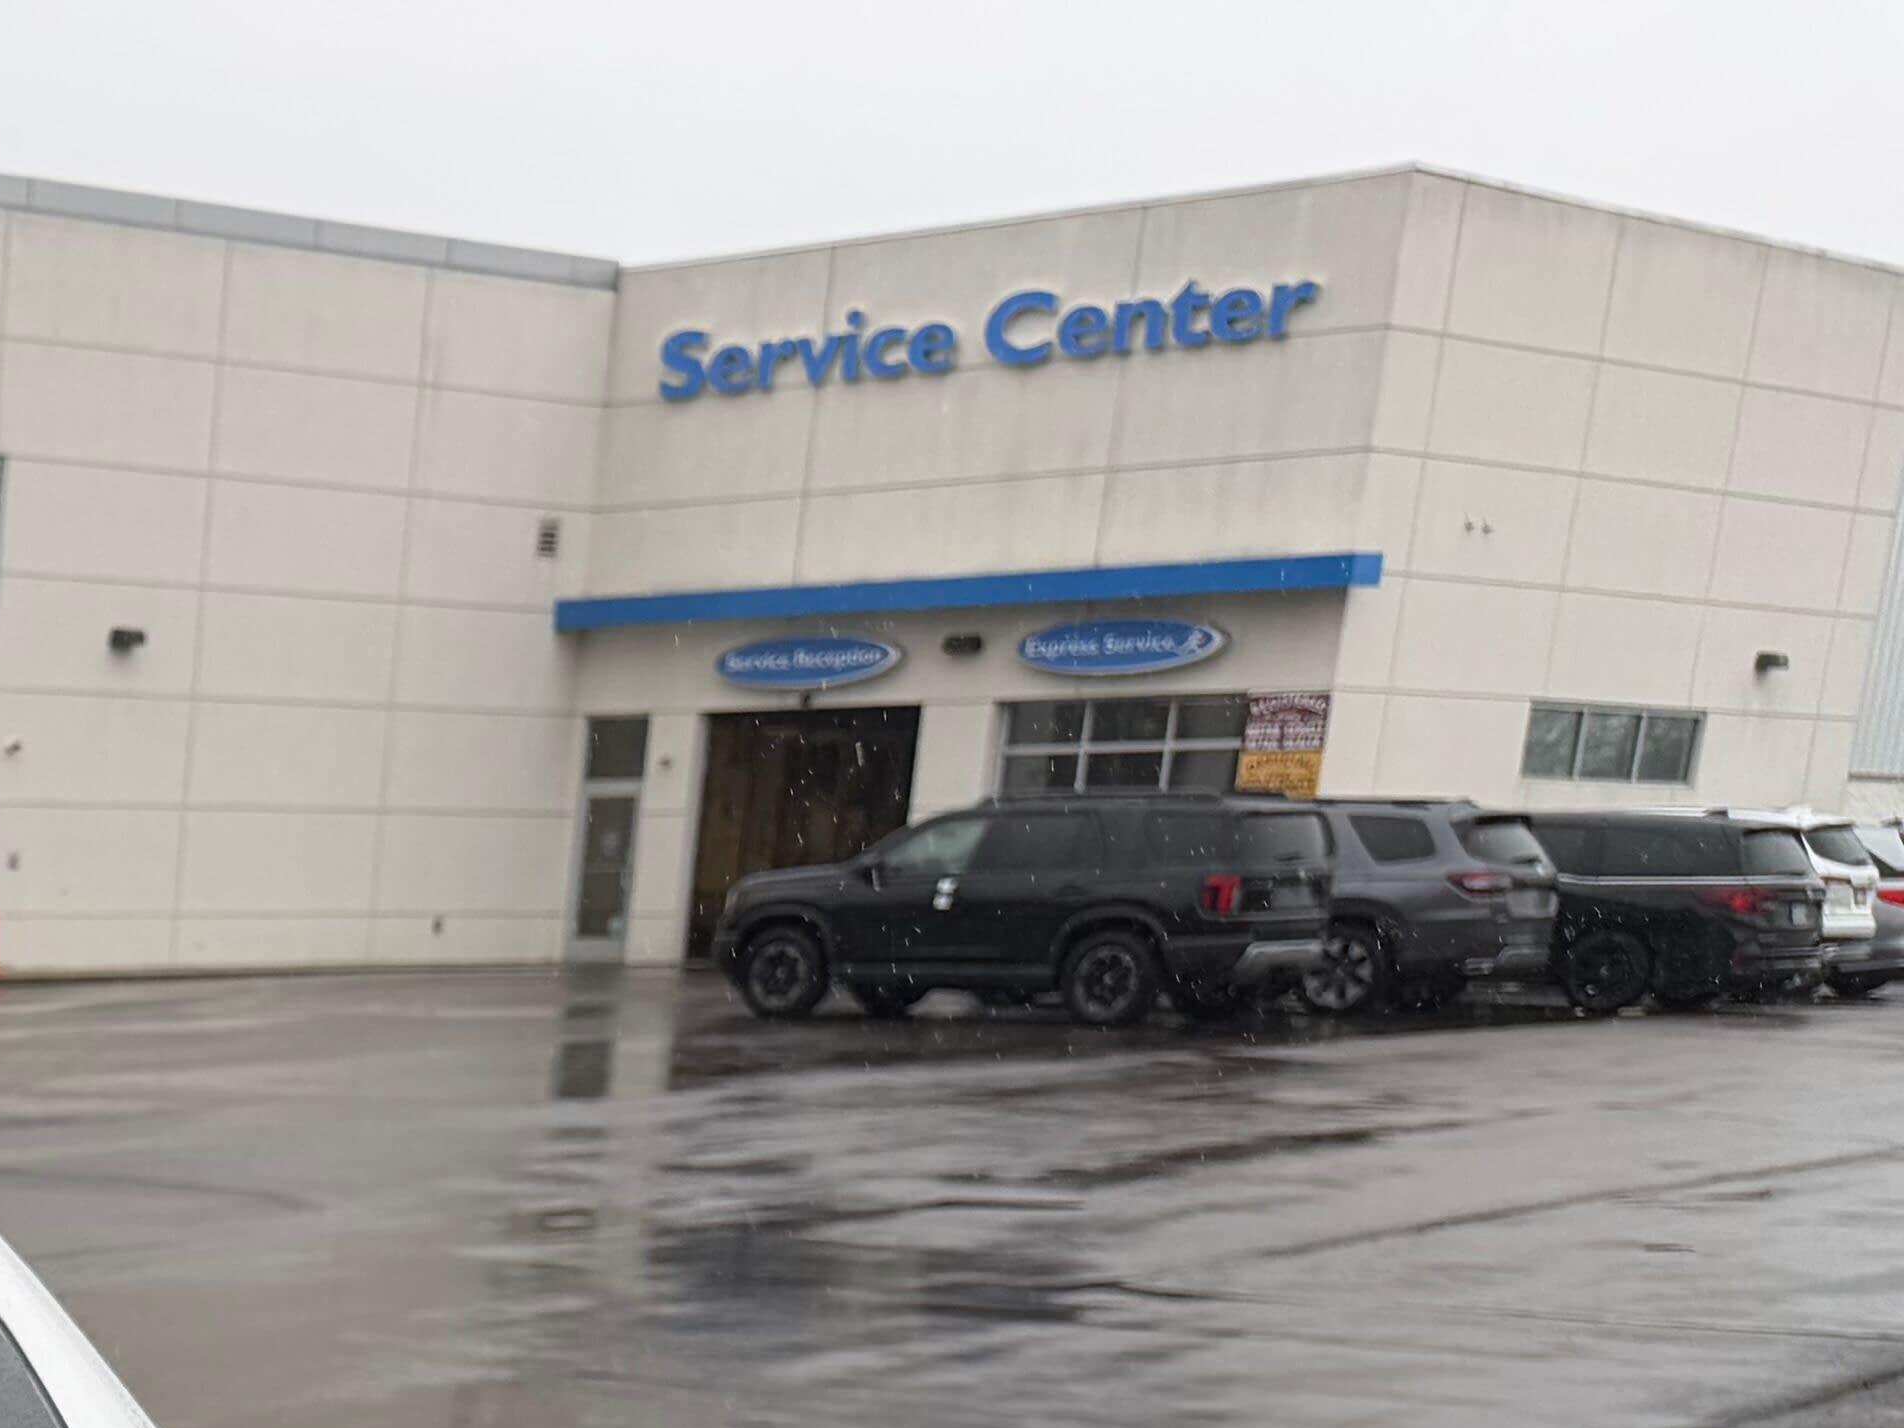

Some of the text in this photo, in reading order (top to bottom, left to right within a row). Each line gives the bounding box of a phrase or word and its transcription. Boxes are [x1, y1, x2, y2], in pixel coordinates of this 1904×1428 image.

[659, 280, 1321, 400] Service Center
[1025, 631, 1175, 660] Express Service
